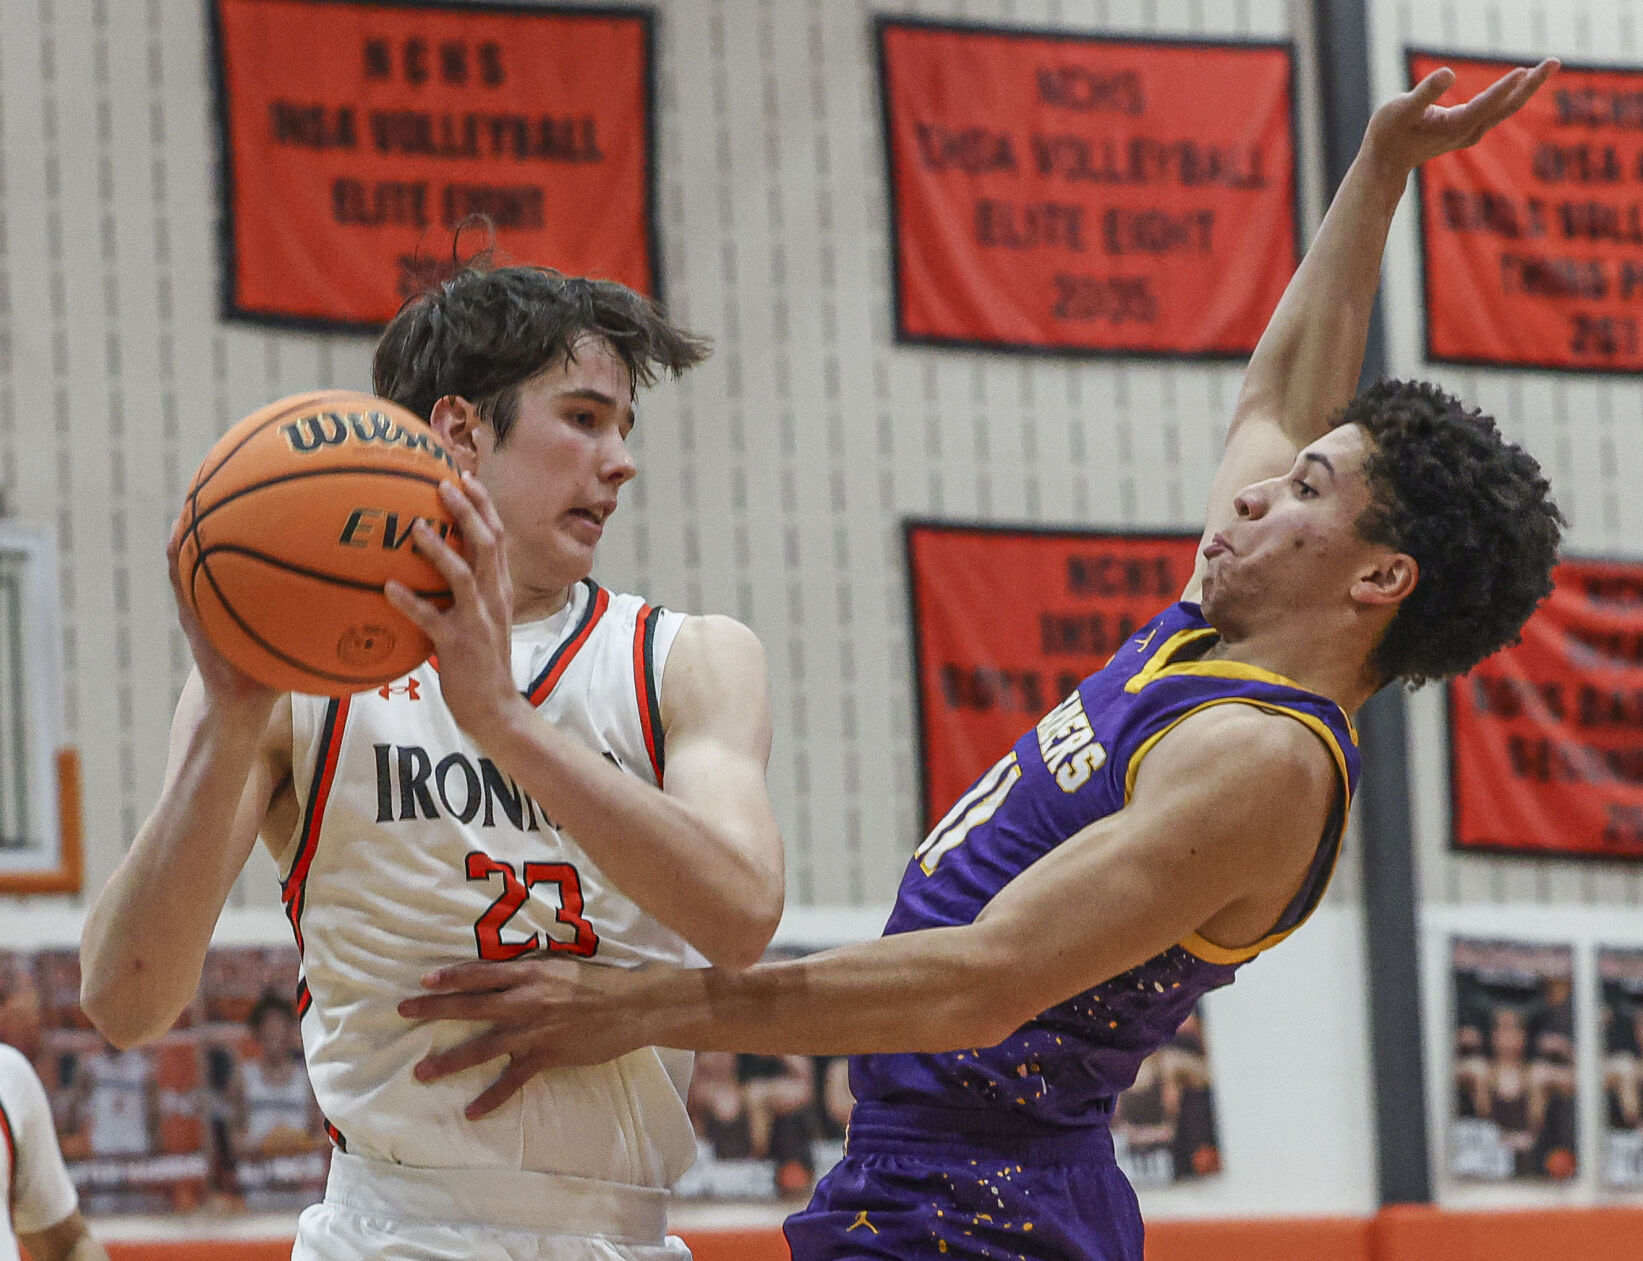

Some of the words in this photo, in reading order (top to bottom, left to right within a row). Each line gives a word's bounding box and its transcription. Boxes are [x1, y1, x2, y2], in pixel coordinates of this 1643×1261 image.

[370, 108, 602, 163] VOLLEYBALL
[1029, 132, 1267, 190] VOLLEYBALL
[464, 850, 600, 961] 23
